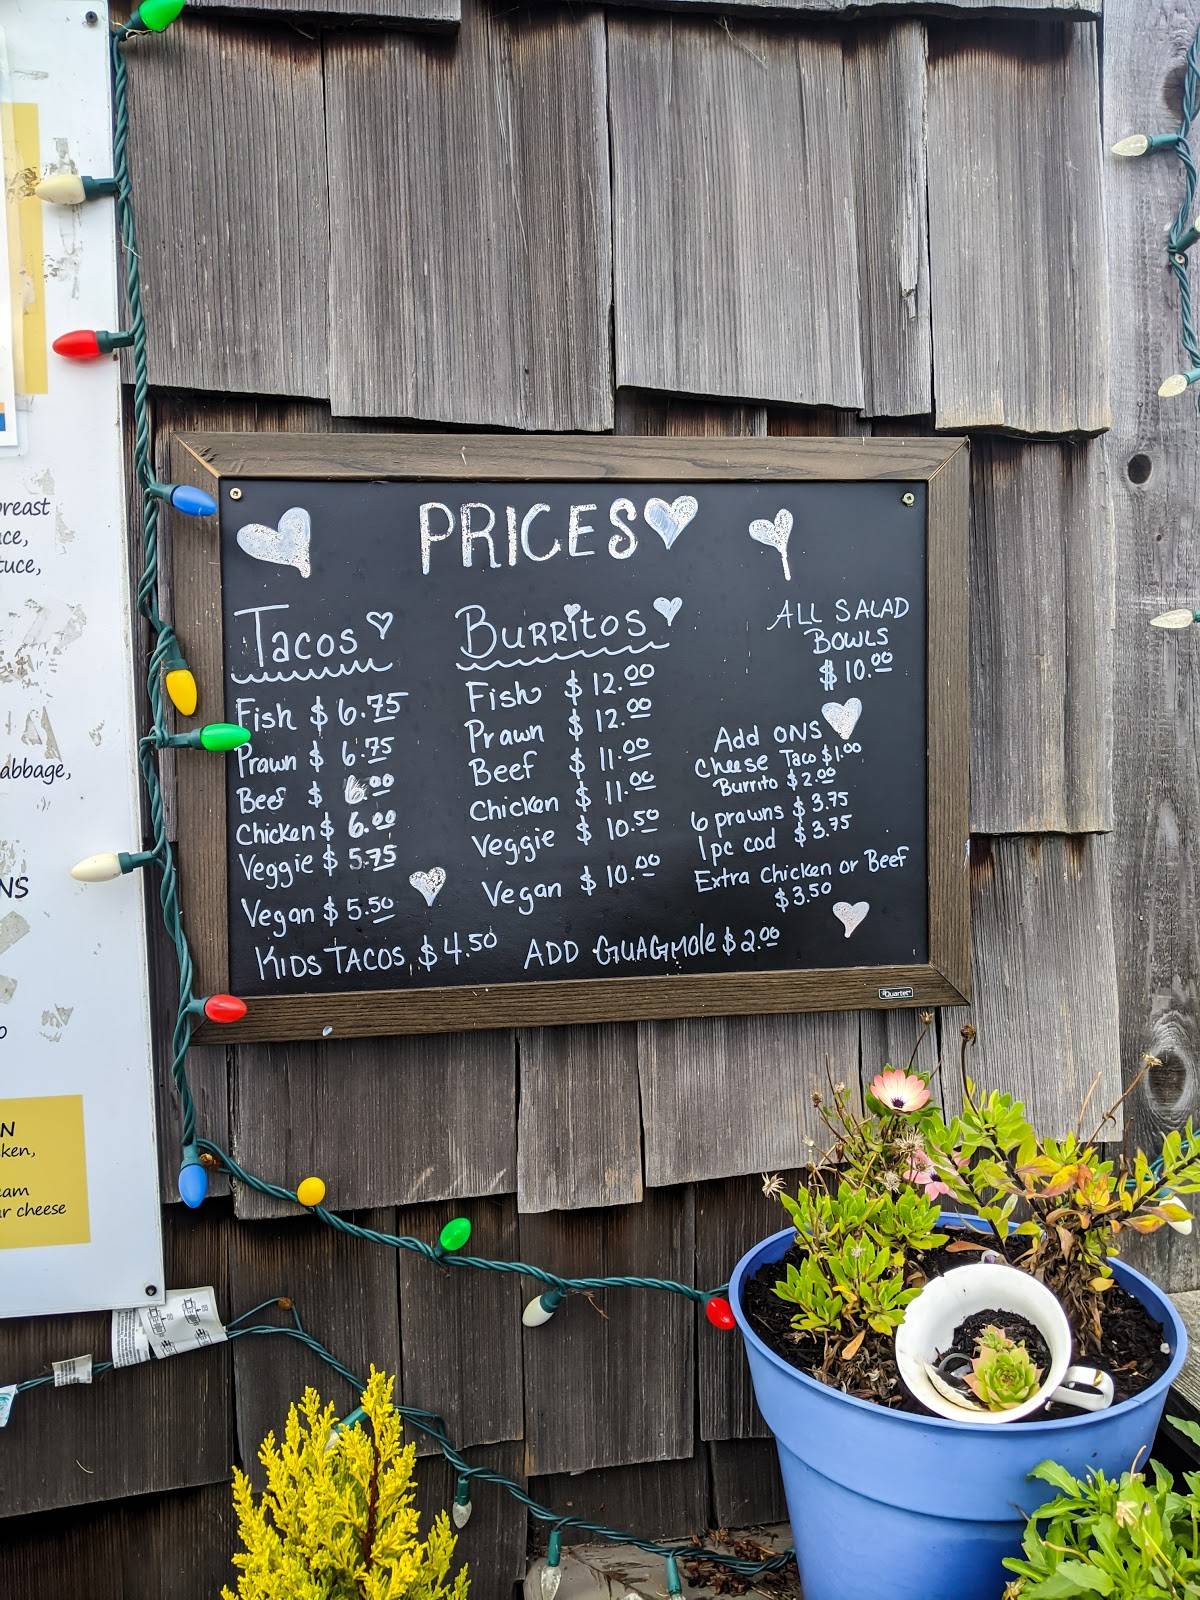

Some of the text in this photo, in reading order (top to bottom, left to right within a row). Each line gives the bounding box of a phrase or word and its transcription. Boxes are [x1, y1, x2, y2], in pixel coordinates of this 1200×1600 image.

[0, 497, 51, 516] reast
[419, 498, 638, 575] PRICES
[767, 596, 910, 631] ALL SALAD
[233, 604, 358, 668] Tacos
[803, 627, 889, 655] BOWLS
[465, 680, 543, 712] Fish
[593, 663, 655, 696] 12.00
[235, 697, 297, 733] Fish
[463, 719, 545, 753] Prawn
[596, 697, 652, 732] 12.00
[713, 724, 761, 753] Add
[234, 742, 297, 778] Prawn
[468, 751, 538, 787] Beef
[599, 737, 652, 771] 11.00
[694, 753, 769, 779] Cheese
[778, 749, 817, 769] Taco
[236, 786, 287, 815] Beef
[469, 796, 559, 823] Chicken
[605, 770, 657, 806] 11.00
[712, 778, 779, 797] Burrito
[236, 822, 316, 846] Chicken
[471, 827, 555, 866] Veggie
[606, 808, 660, 841] 10.50
[691, 811, 708, 832] 6
[715, 806, 785, 838] prawns
[743, 827, 776, 853] cod
[238, 851, 314, 891] Veggie
[481, 880, 562, 915] Vegan
[606, 853, 661, 888] 10.00
[694, 846, 910, 893] Extra Chicken or Beef
[240, 897, 315, 938] Vegan
[254, 944, 323, 981] KIDS
[323, 944, 406, 975] TACOS
[523, 937, 579, 969] ADD
[16, 1203, 67, 1219] cheese
